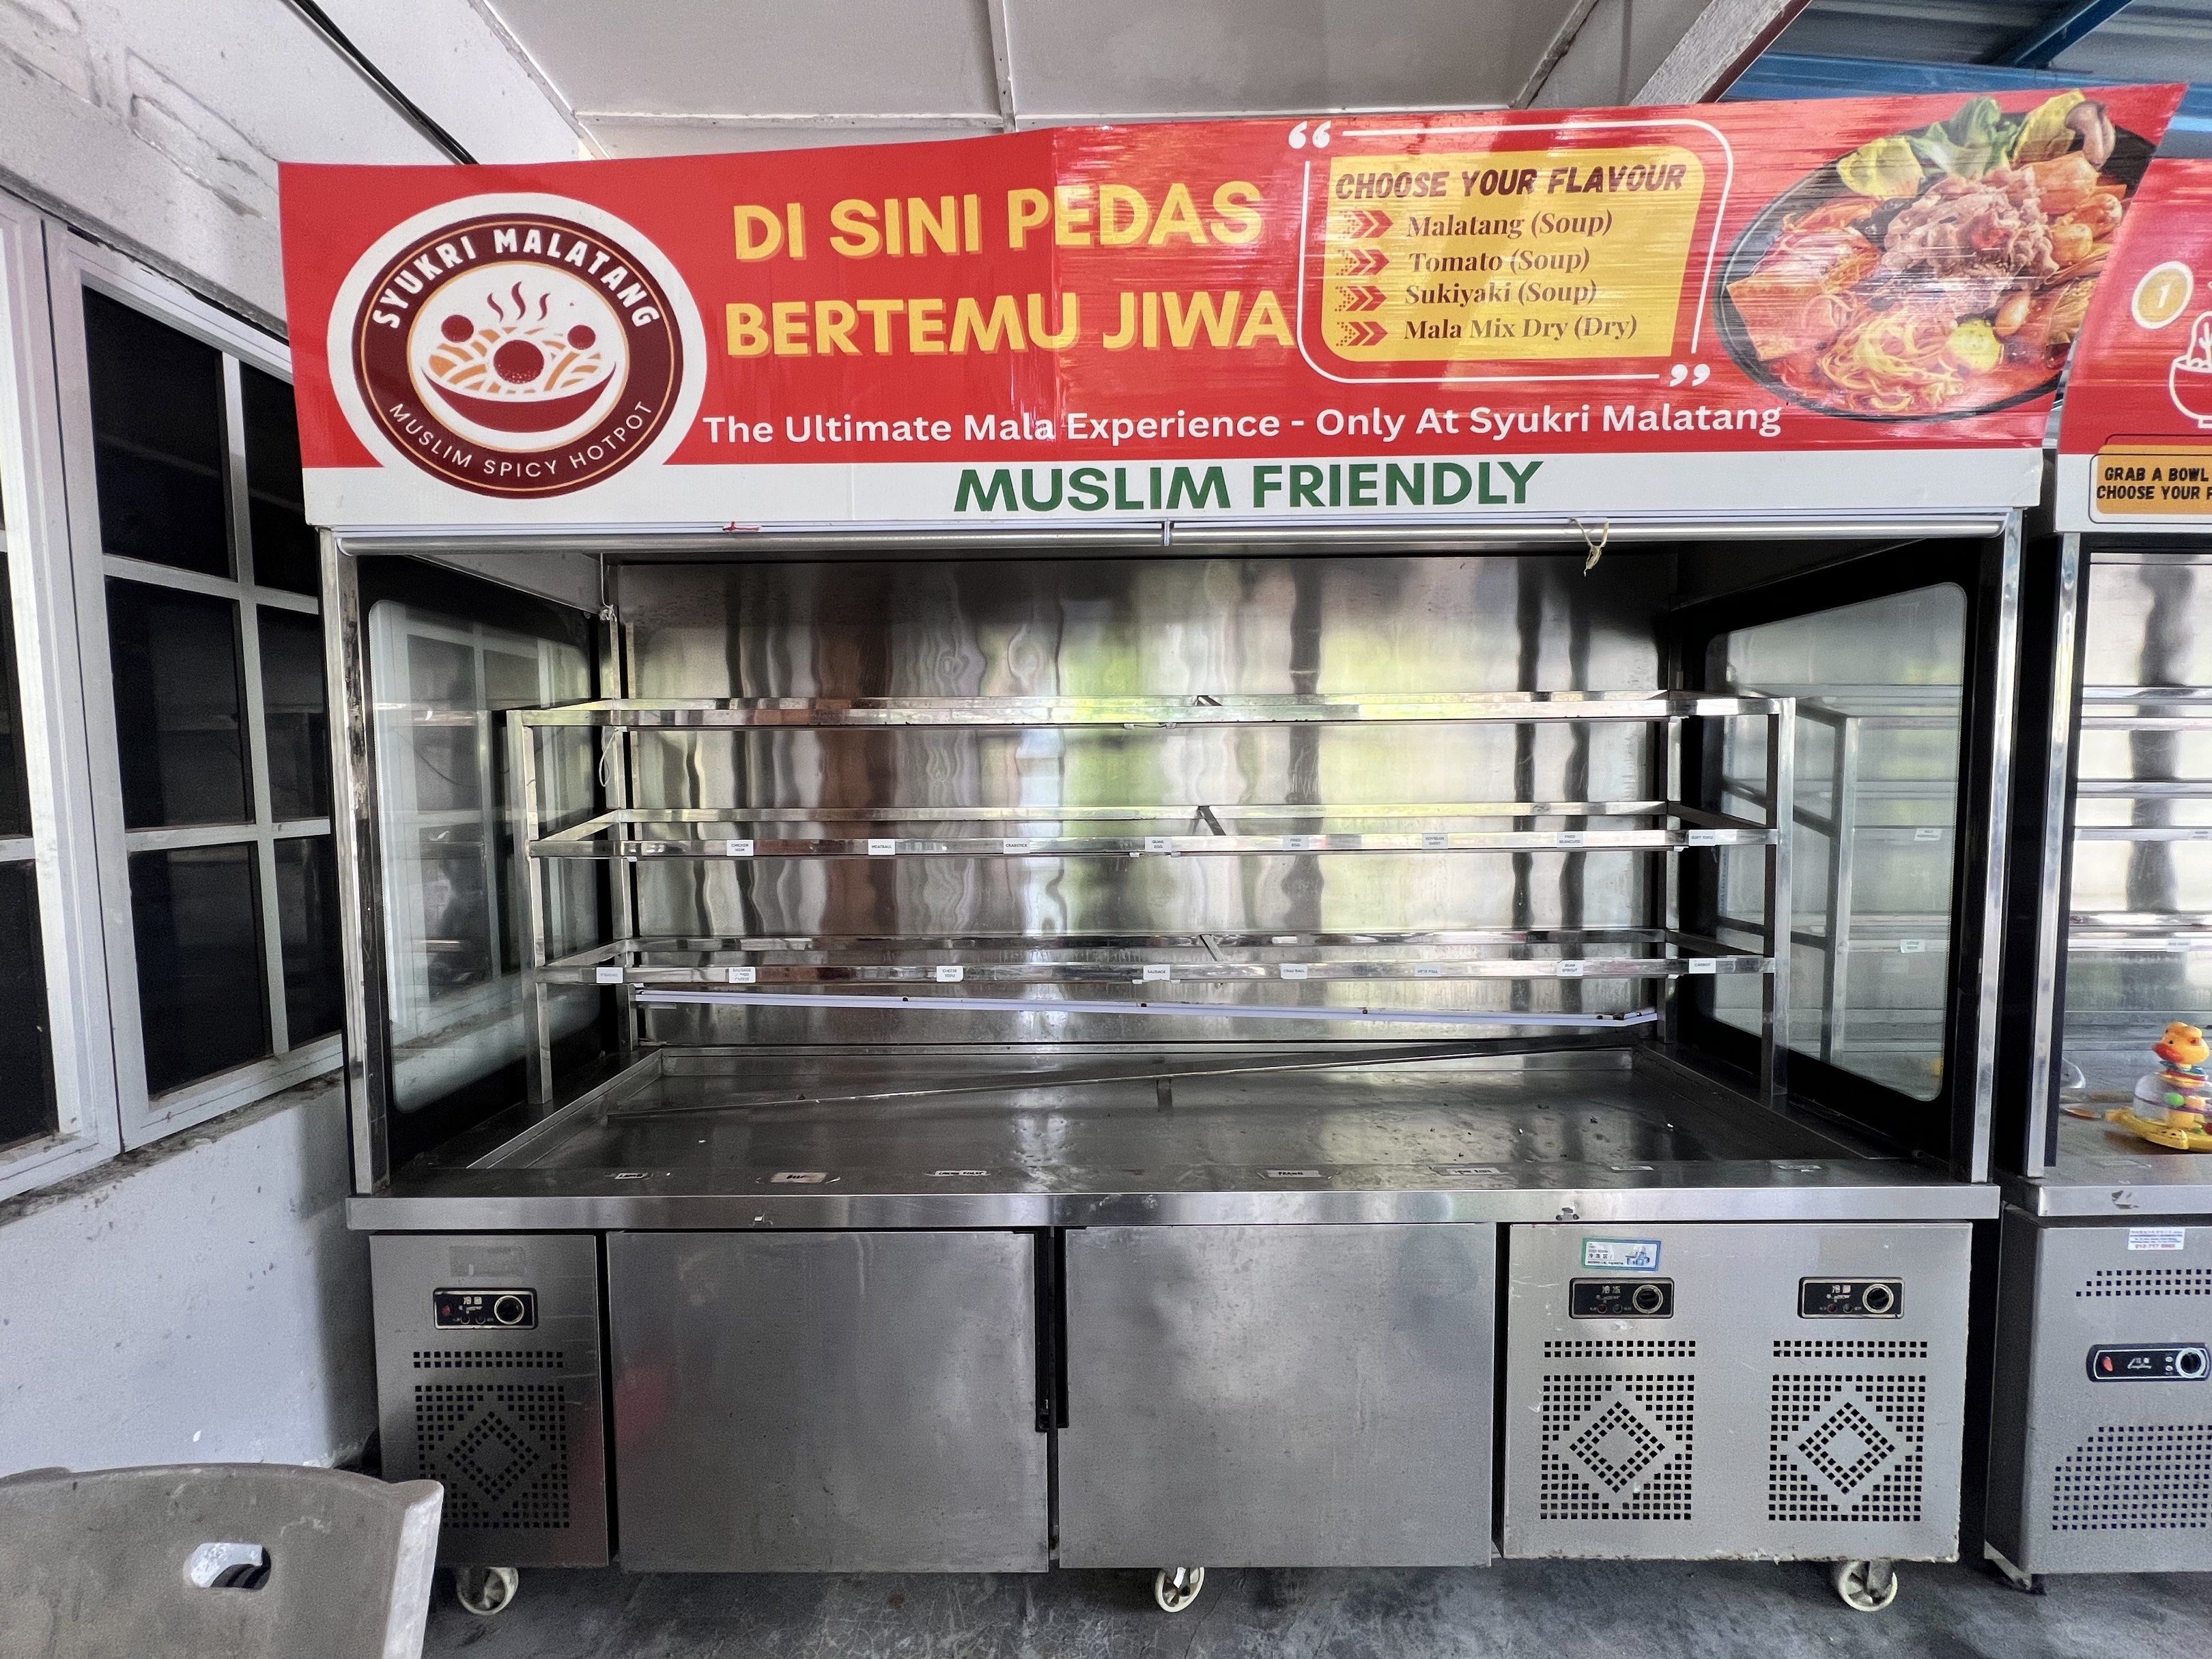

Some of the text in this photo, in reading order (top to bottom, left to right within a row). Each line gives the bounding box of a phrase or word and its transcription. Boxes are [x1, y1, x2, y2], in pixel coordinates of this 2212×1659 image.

[1335, 163, 1687, 199] CHOOSE YOUR FLAVOUR
[733, 179, 1264, 261] DI SINI PEDAS
[1408, 210, 1613, 239] Malatang (Soup)
[1409, 247, 1590, 272] Tomato (Soup)
[373, 228, 661, 329] SYUKRI MALATANG
[1405, 280, 1598, 307] Sukiyaki (Soup)
[2157, 282, 2172, 309] 1
[726, 289, 1295, 356] BERTEMU JIWA
[1404, 314, 1638, 341] Mala Mix Dry (Dry)
[390, 401, 652, 478] MUSLIM SPICY HOTPOT
[703, 416, 773, 444] The
[786, 414, 952, 442] Ultimate
[965, 412, 1055, 442] Mala
[1068, 410, 1280, 446] Experience
[1316, 408, 1406, 442] Only
[1415, 407, 1460, 434] At
[1469, 404, 1590, 441] Syukri
[1603, 403, 1784, 438] Malatang
[954, 461, 1544, 513] MUSLIM FRIENDLY
[2105, 467, 2209, 481] GRAB A BOWL
[2097, 485, 2155, 500] CHOOSE
[2161, 485, 2200, 500] YOUR
